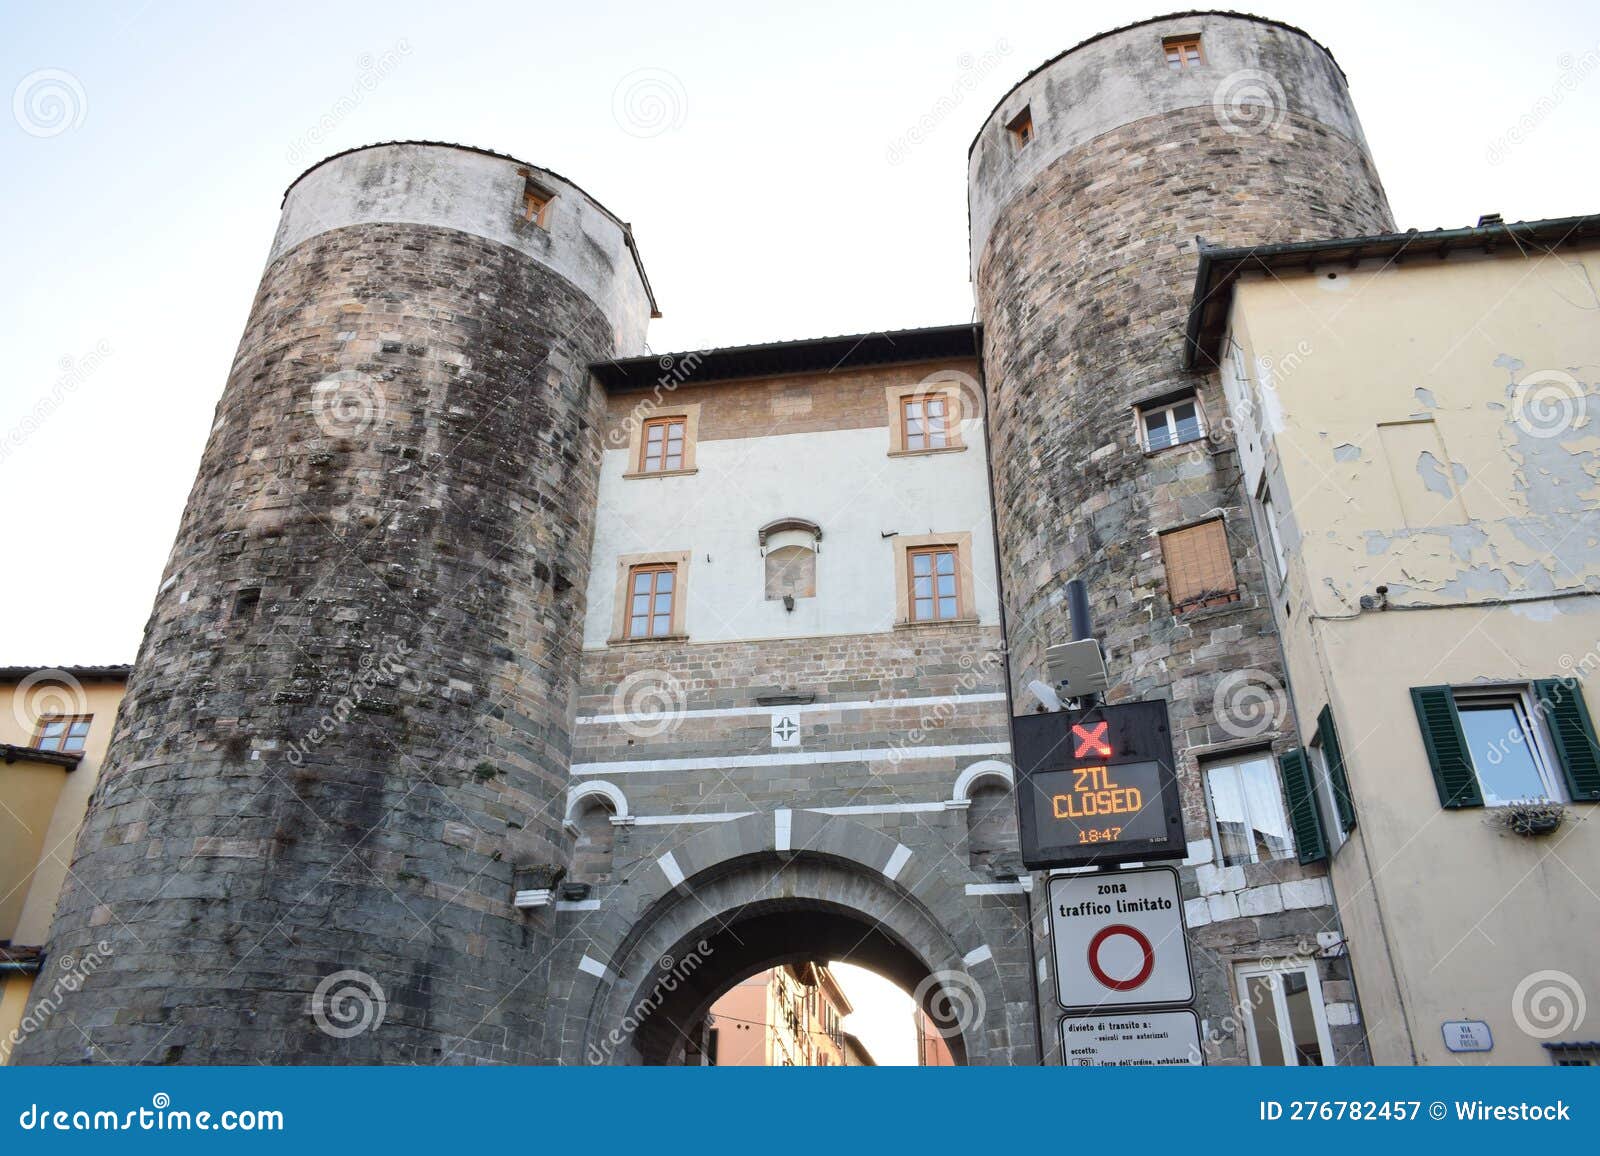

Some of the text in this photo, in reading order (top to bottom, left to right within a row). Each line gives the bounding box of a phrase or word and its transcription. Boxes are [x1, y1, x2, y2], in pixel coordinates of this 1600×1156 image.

[1072, 766, 1118, 792] ZTL
[1053, 787, 1142, 818] CLOSED
[1079, 827, 1121, 843] 18:47
[1097, 883, 1127, 895] zona
[1059, 897, 1172, 917] traffico limitato
[1068, 1021, 1152, 1032] divieto di transito a:
[1136, 1032, 1169, 1040] autorizzati
[1070, 1047, 1099, 1056] eccetto:
